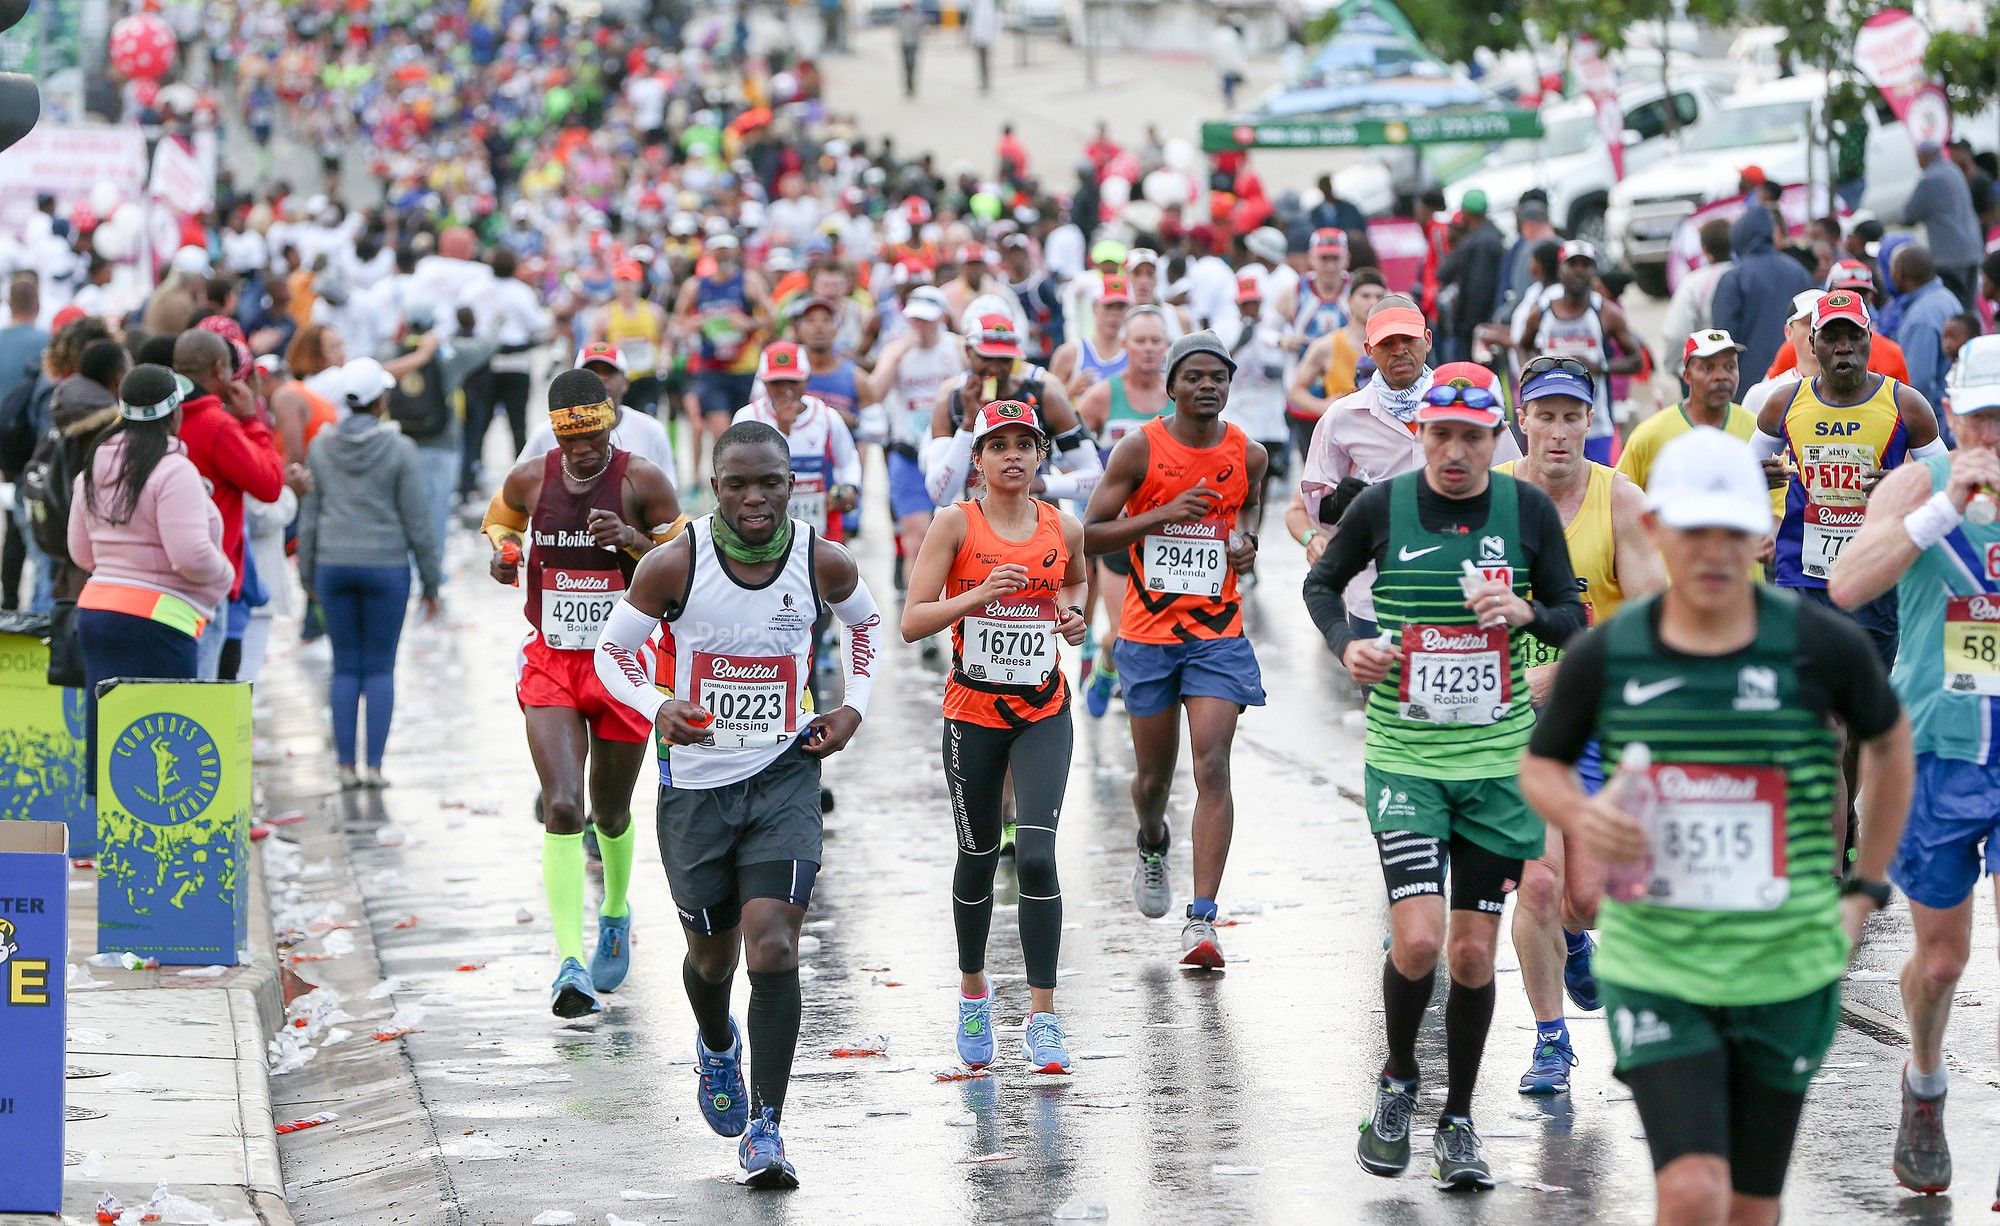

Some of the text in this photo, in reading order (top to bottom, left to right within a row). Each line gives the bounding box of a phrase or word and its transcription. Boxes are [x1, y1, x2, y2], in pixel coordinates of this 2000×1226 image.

[1815, 422, 1860, 436] SAP
[1804, 465, 1815, 489] P
[1818, 506, 1865, 524] Bonita
[535, 530, 597, 547] Run Boikie
[1163, 523, 1217, 538] Bonitas
[1155, 545, 1218, 570] 29418
[555, 571, 609, 590] Bonitas
[1168, 567, 1206, 578] Tatenda
[1182, 581, 1189, 590] 0
[1211, 582, 1219, 594] D
[553, 600, 613, 622] 42062
[985, 600, 1040, 617] Bonitas
[567, 623, 598, 632] Boikie
[978, 620, 1006, 629] COMRADES
[579, 637, 586, 646] 7
[978, 628, 1045, 657] 16702
[1420, 627, 1489, 651] Bonitas
[711, 657, 779, 679] Bonitas
[990, 654, 1031, 667] Raeesa
[969, 665, 984, 675] ASA
[1006, 671, 1014, 681] 0
[1417, 664, 1496, 693] 14235
[703, 681, 737, 690] COMRADES
[705, 691, 782, 720] 10223
[1434, 693, 1480, 705] Robbie
[715, 719, 769, 732] Blessing
[116, 716, 198, 757] COMRADES
[738, 737, 744, 746] 1
[951, 739, 960, 770] asics
[954, 780, 976, 850] FRONTRUNNER
[1663, 821, 1754, 860] 8515
[1391, 881, 1439, 899] COMPRE
[1, 897, 44, 914] TER
[8, 957, 49, 1006] E
